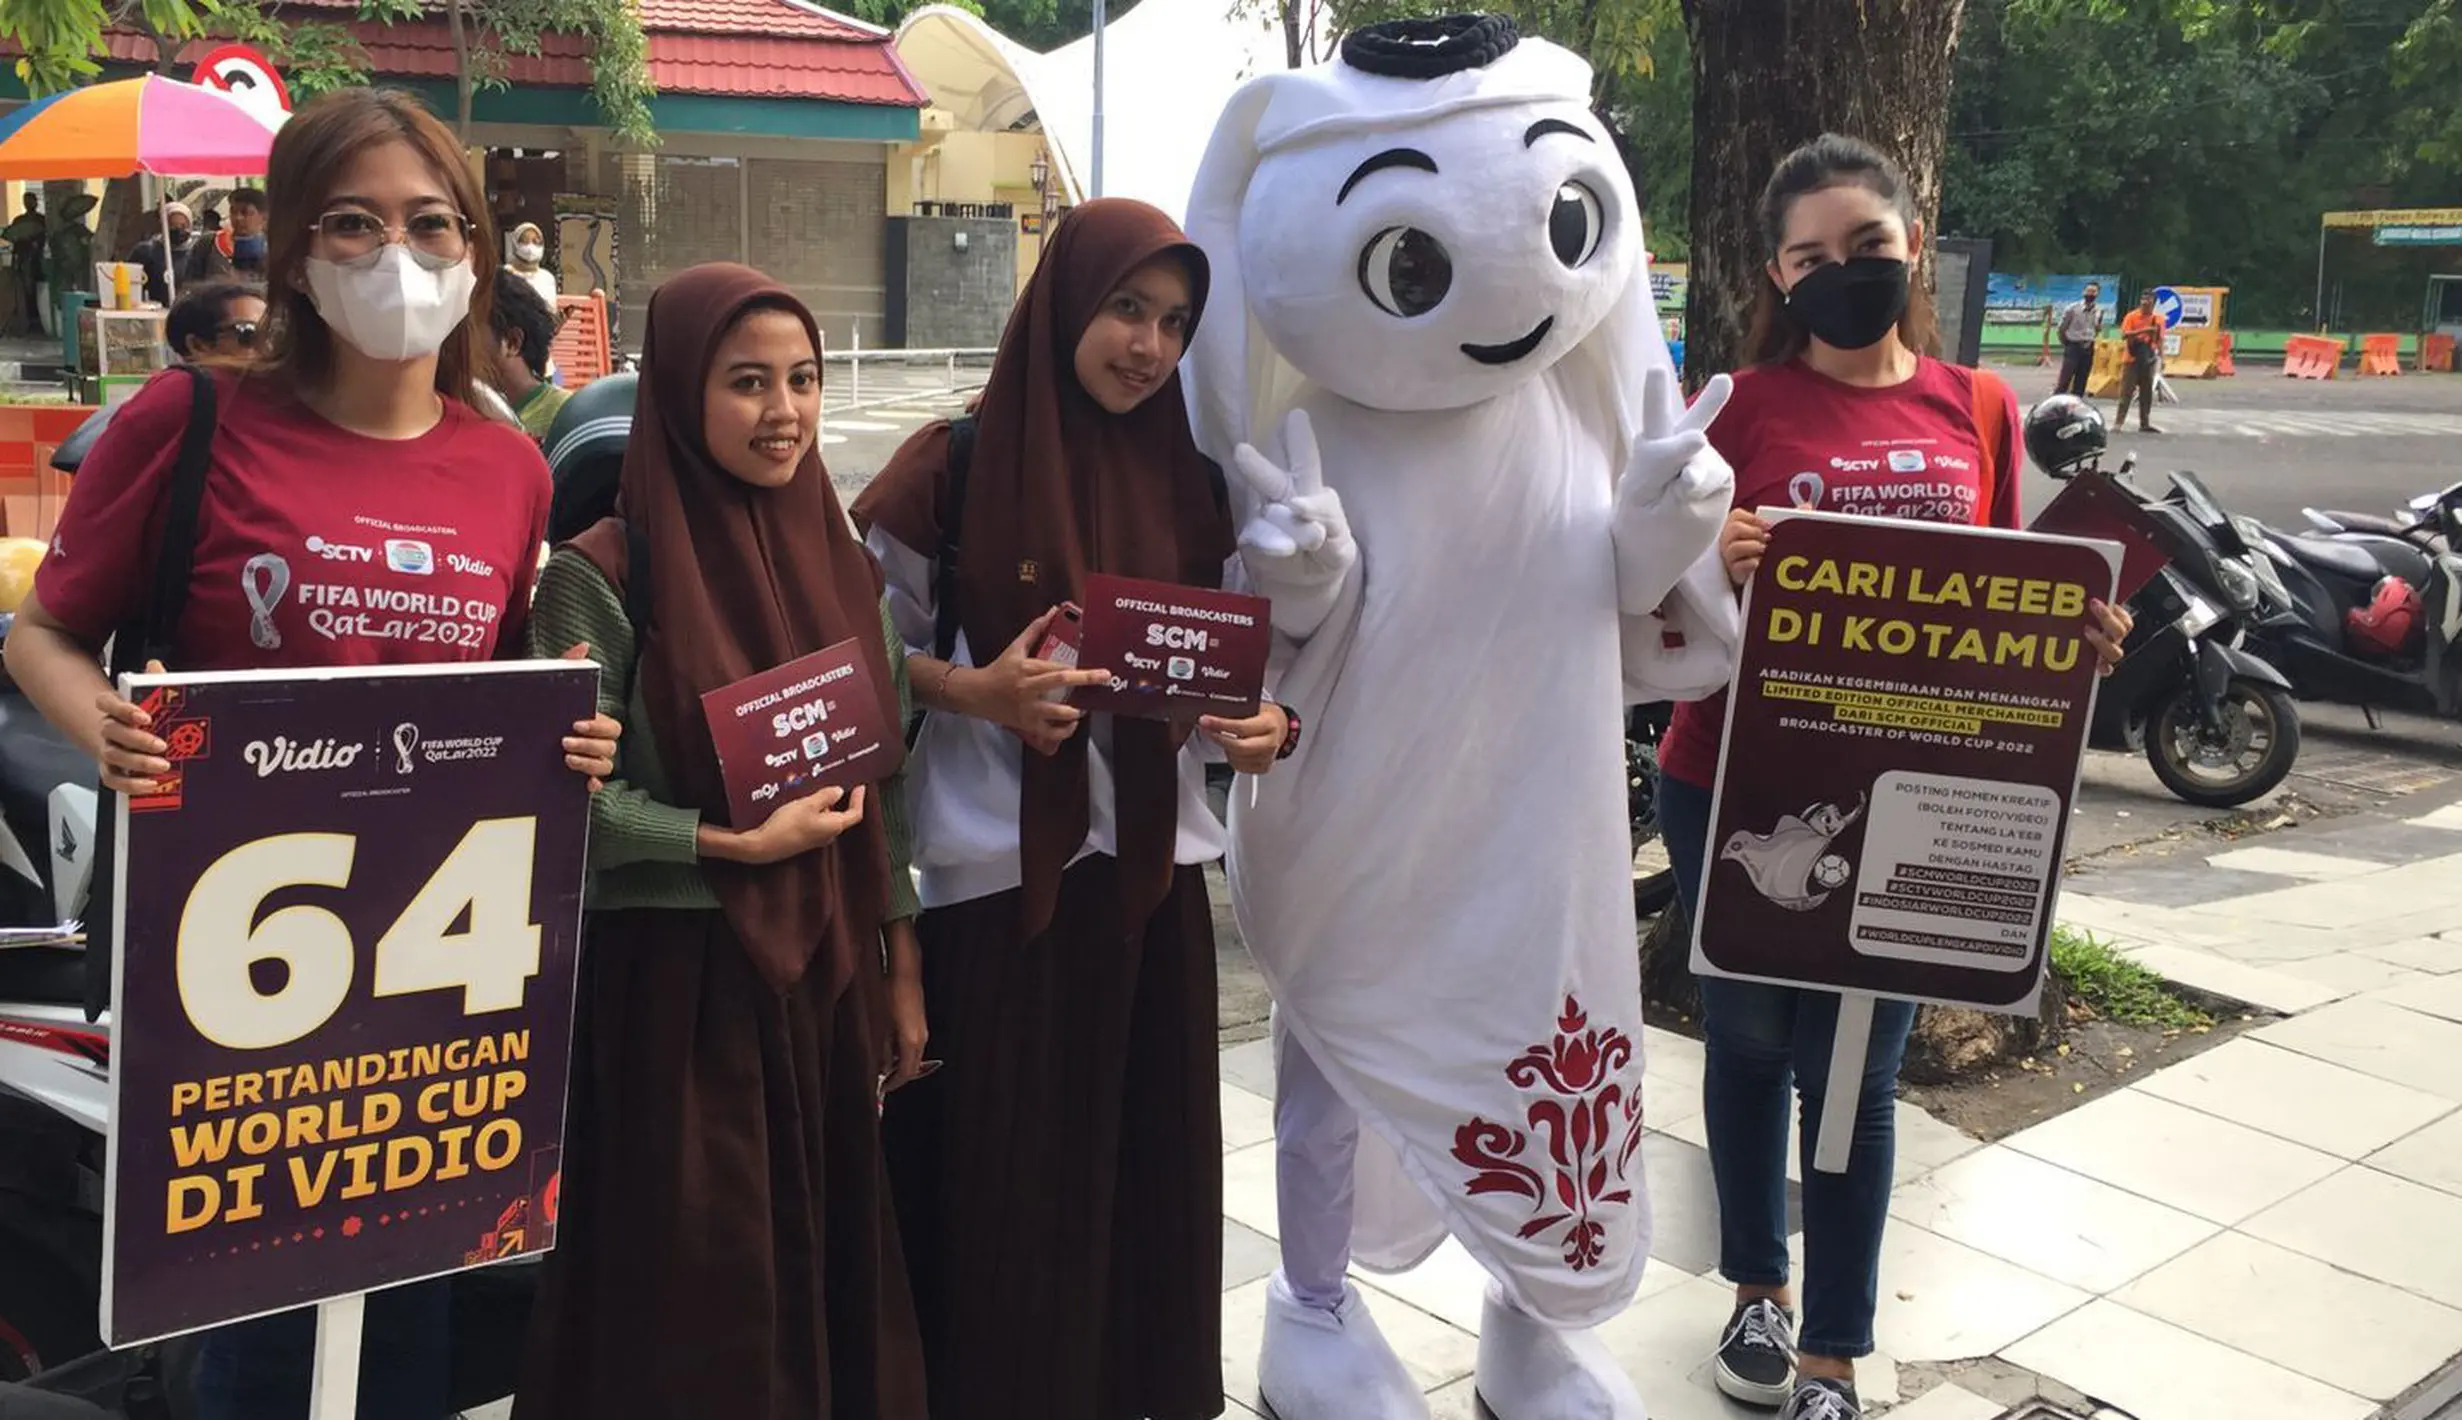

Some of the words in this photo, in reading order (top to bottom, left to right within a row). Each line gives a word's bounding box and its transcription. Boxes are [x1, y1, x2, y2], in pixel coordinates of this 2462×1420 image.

[1843, 459, 1879, 472] SCTV
[1832, 486, 1876, 502] FIFA
[1879, 483, 1951, 500] WORLD
[354, 515, 393, 530] OFFICIAL
[393, 522, 457, 536] BROADCASTERS
[322, 543, 373, 563] SCTV
[446, 554, 494, 577] Vidio
[1775, 555, 1896, 600] CARI
[1907, 567, 2086, 618] LA'EEB
[298, 583, 360, 607] FIFA
[364, 589, 460, 617] WORLD
[464, 600, 497, 624] CUP
[1116, 597, 1168, 615] OFFICIAL
[1169, 605, 1254, 626] BROADCASTERS
[308, 608, 485, 648] Qatar2022
[1146, 623, 1208, 652] SCM
[1767, 608, 1823, 645] DI
[1841, 615, 2080, 671] KOTAMU
[1132, 658, 1161, 670] SCTV
[736, 691, 782, 717] OFFICIAL
[781, 663, 854, 700] BROADCASTERS
[1759, 668, 1834, 685] ABADIKAN
[1837, 675, 1940, 698] KEGEMBIRAAN
[1944, 686, 1975, 700] DAN
[1978, 690, 2071, 710] MENANGKAN
[772, 699, 828, 738] SCM
[1765, 684, 1821, 700] LIMITED
[1824, 692, 1884, 707] EDITION
[1887, 698, 1951, 714] OFFICIAL
[1955, 704, 2060, 725] MERCHANDISE
[1838, 708, 1873, 721] DARI
[1876, 712, 1906, 724] SCM
[1909, 716, 1976, 732] OFFICIAL
[421, 739, 444, 750] FIFA
[445, 738, 482, 749] WORLD
[483, 736, 503, 747] CUP
[1779, 716, 1883, 739] BROADCASTER
[1887, 729, 1905, 740] OF
[1909, 732, 1961, 747] WORLD
[1964, 738, 1994, 750] CUP
[1996, 741, 2035, 754] 2022
[244, 736, 363, 778] Vidio
[1895, 782, 1949, 798] POSTING
[1951, 789, 1999, 802] MOMEN
[2001, 795, 2051, 808] KREATIF
[1917, 801, 1964, 816] (BOLEH
[1965, 807, 2049, 825] FOTO/VIDEO)
[1940, 821, 1997, 836] TENTANG
[1932, 838, 1948, 848] KE
[1951, 839, 2003, 854] SOSMED
[2005, 848, 2042, 859] KAMU
[1928, 853, 1980, 868] DENGAN
[1982, 861, 2033, 875] HASTAG
[1900, 866, 2037, 892] #SCMWORLDCUP2022
[1861, 895, 2031, 923] #INDOSIARWORLDCUP2022
[1890, 882, 2033, 908] #SCTVWORLDCUP2022
[176, 816, 542, 1050] 64
[2000, 929, 2027, 939] DAN
[171, 1030, 531, 1116] PERTANDINGAN
[169, 1092, 402, 1168] WORLD
[417, 1070, 527, 1122] CUP
[166, 1162, 266, 1234] DI
[288, 1118, 523, 1209] VIDIO
